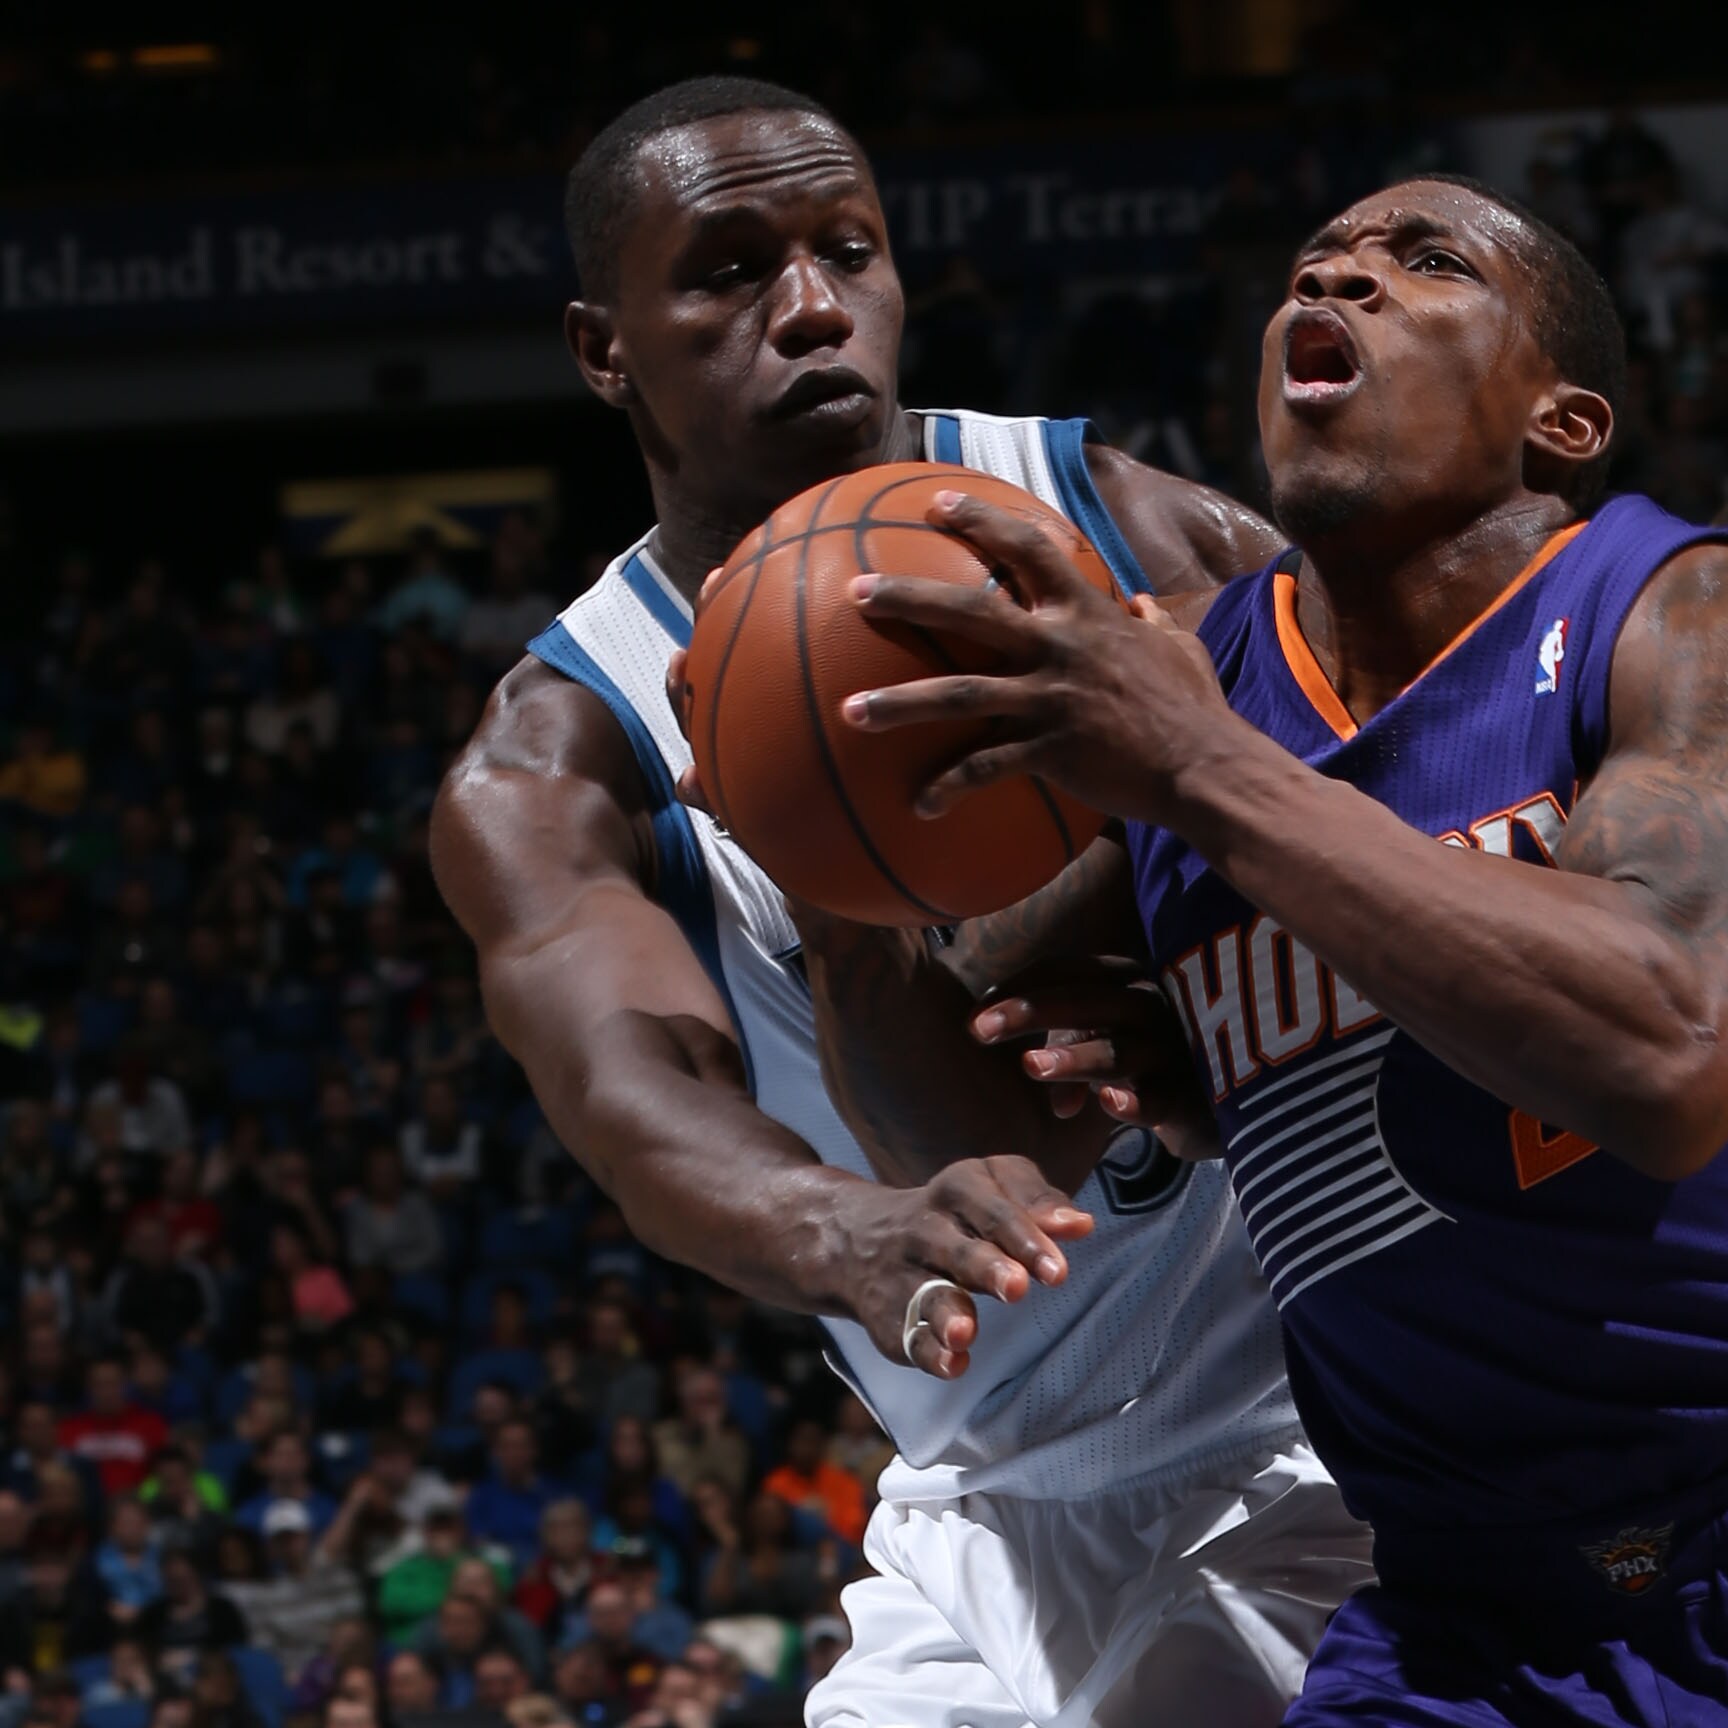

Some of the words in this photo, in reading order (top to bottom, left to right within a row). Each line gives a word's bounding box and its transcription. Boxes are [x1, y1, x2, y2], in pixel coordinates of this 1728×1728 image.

[0, 224, 217, 310] Island
[234, 223, 466, 296] Resort
[481, 209, 549, 279] &
[1605, 1555, 1660, 1584] PHX
